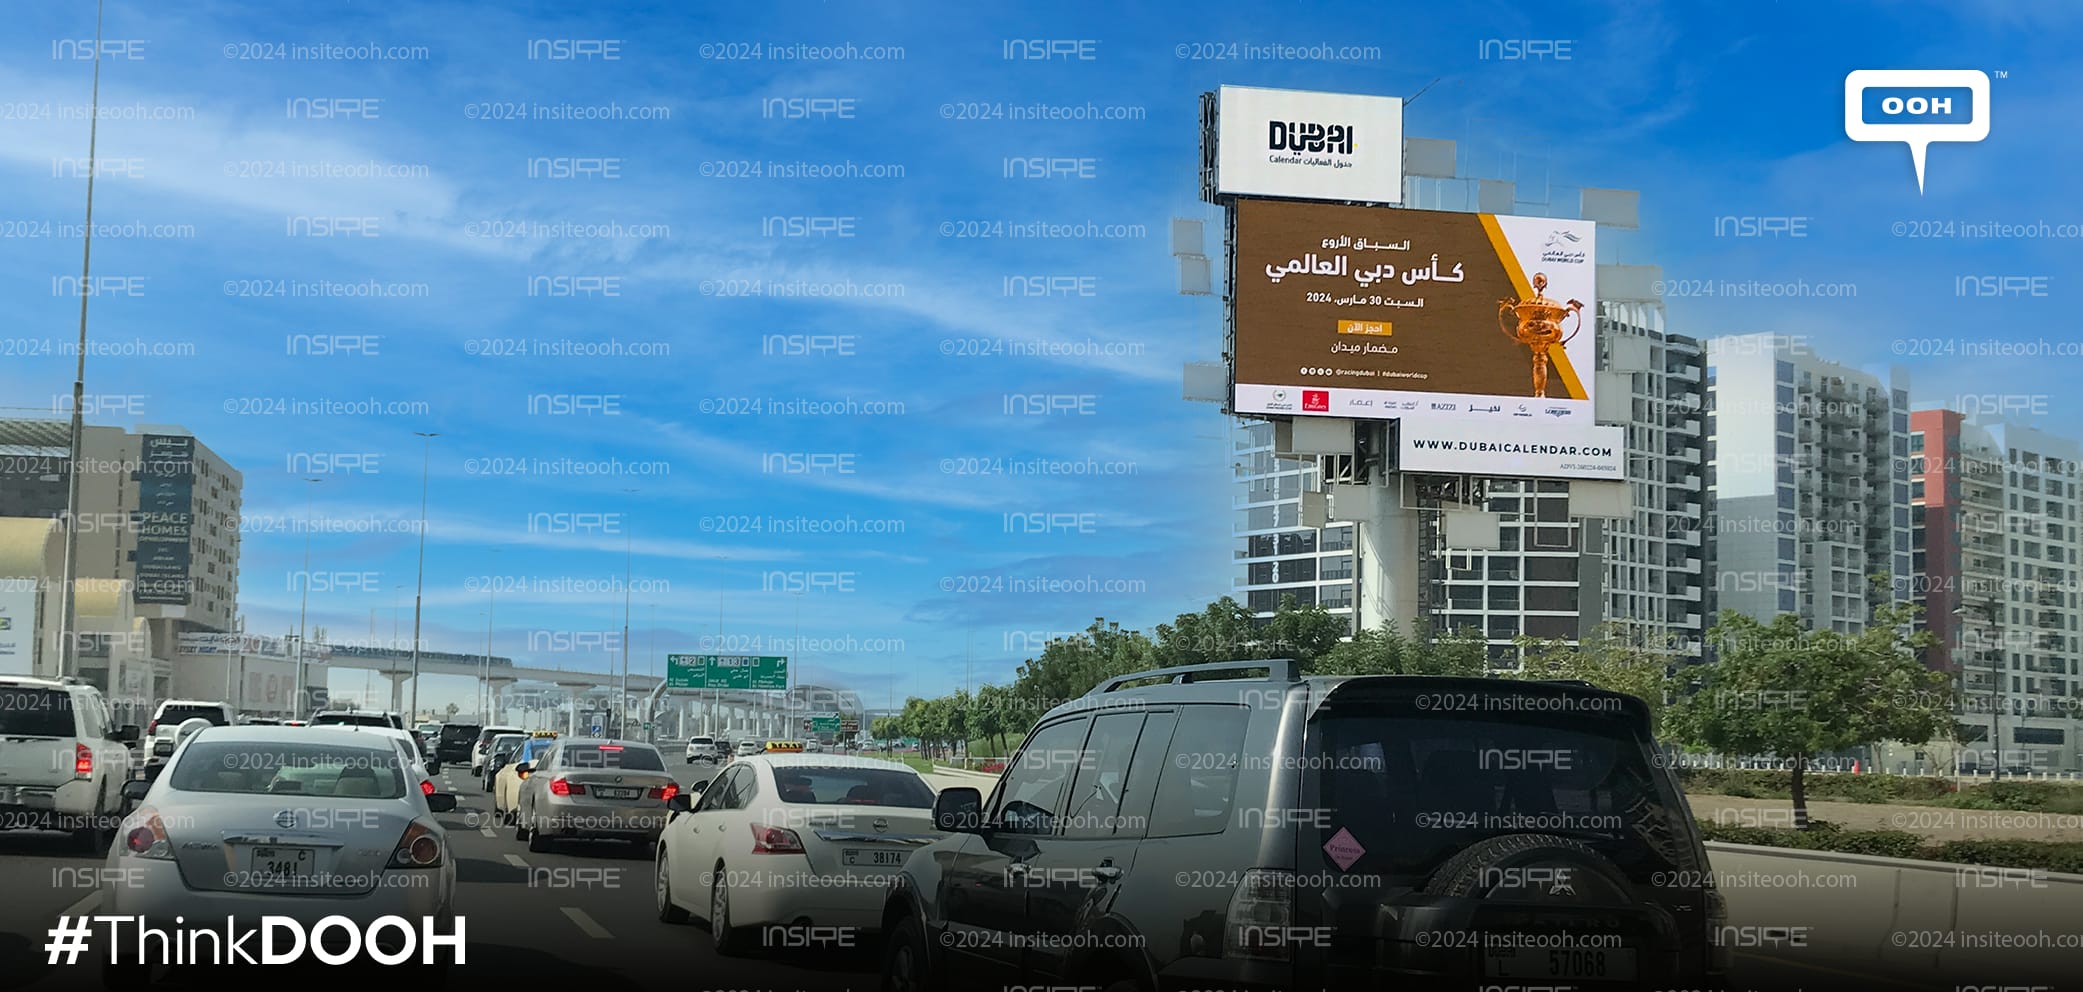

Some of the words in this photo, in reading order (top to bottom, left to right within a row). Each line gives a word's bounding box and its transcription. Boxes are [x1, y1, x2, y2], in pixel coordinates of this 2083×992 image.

[1269, 155, 1301, 164] Calendar
[1265, 253, 1347, 283] العالمي
[1401, 253, 1464, 285] كأس
[1354, 264, 1395, 288] دبي
[1306, 292, 1332, 302] 2024
[1369, 295, 1382, 305] 30
[1384, 296, 1424, 308] السبت
[1331, 340, 1361, 354] ميدان
[1362, 342, 1399, 355] مضمار
[1413, 439, 1612, 457] WWW.DUBAICALENDAR.COM
[143, 511, 188, 524] PEACE
[142, 525, 187, 536] HOMES
[873, 851, 901, 864] 38174
[1549, 950, 1606, 976] 57068
